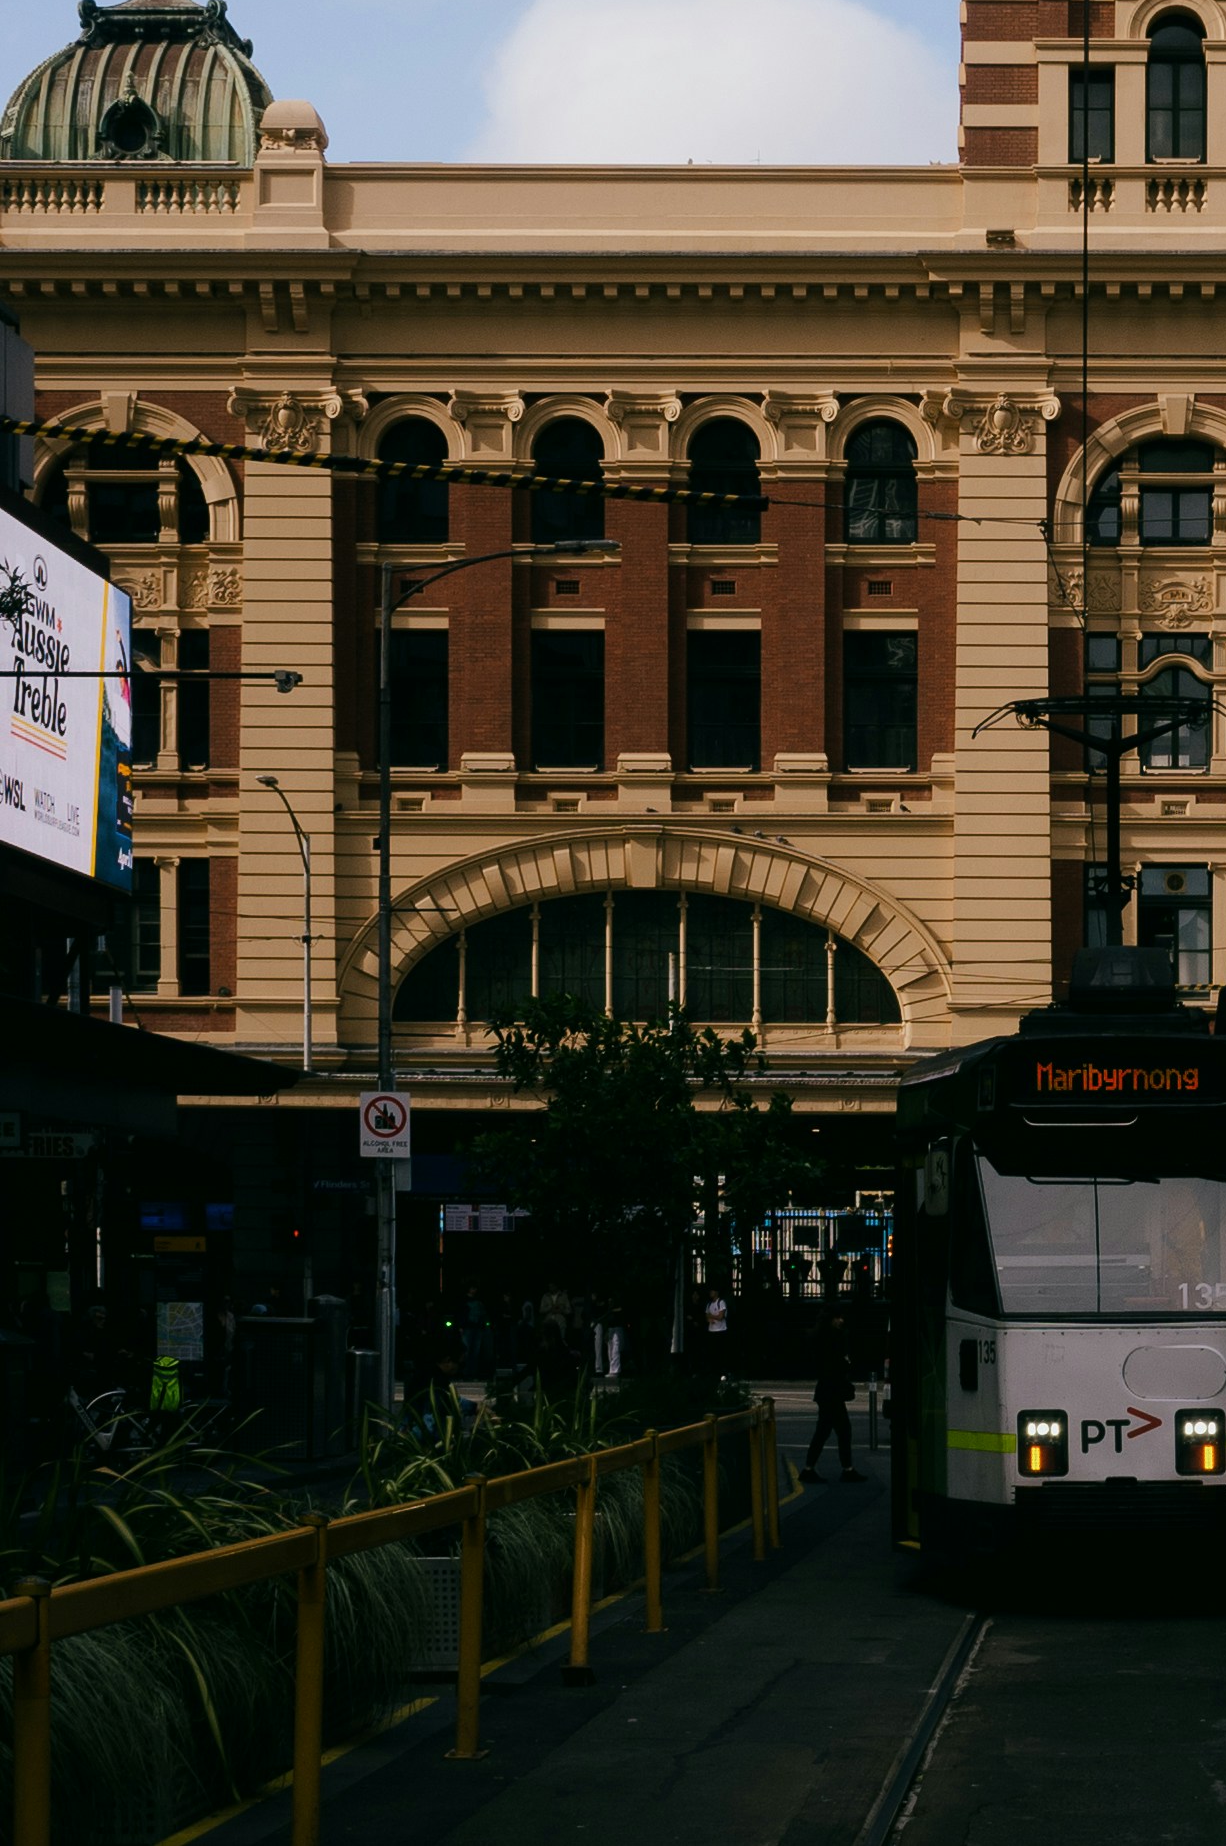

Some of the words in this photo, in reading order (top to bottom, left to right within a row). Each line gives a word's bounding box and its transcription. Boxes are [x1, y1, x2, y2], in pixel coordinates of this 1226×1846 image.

[26, 593, 56, 630] GWM
[11, 612, 70, 673] Aussie
[13, 655, 67, 736] Treble
[4, 773, 27, 812] WSL
[34, 787, 56, 814] WATCH
[66, 802, 80, 825] LIVE
[1036, 1061, 1200, 1092] Maribyrnong
[392, 1140, 409, 1148] FREE
[320, 1180, 358, 1189] Flinders
[978, 1340, 996, 1365] 135
